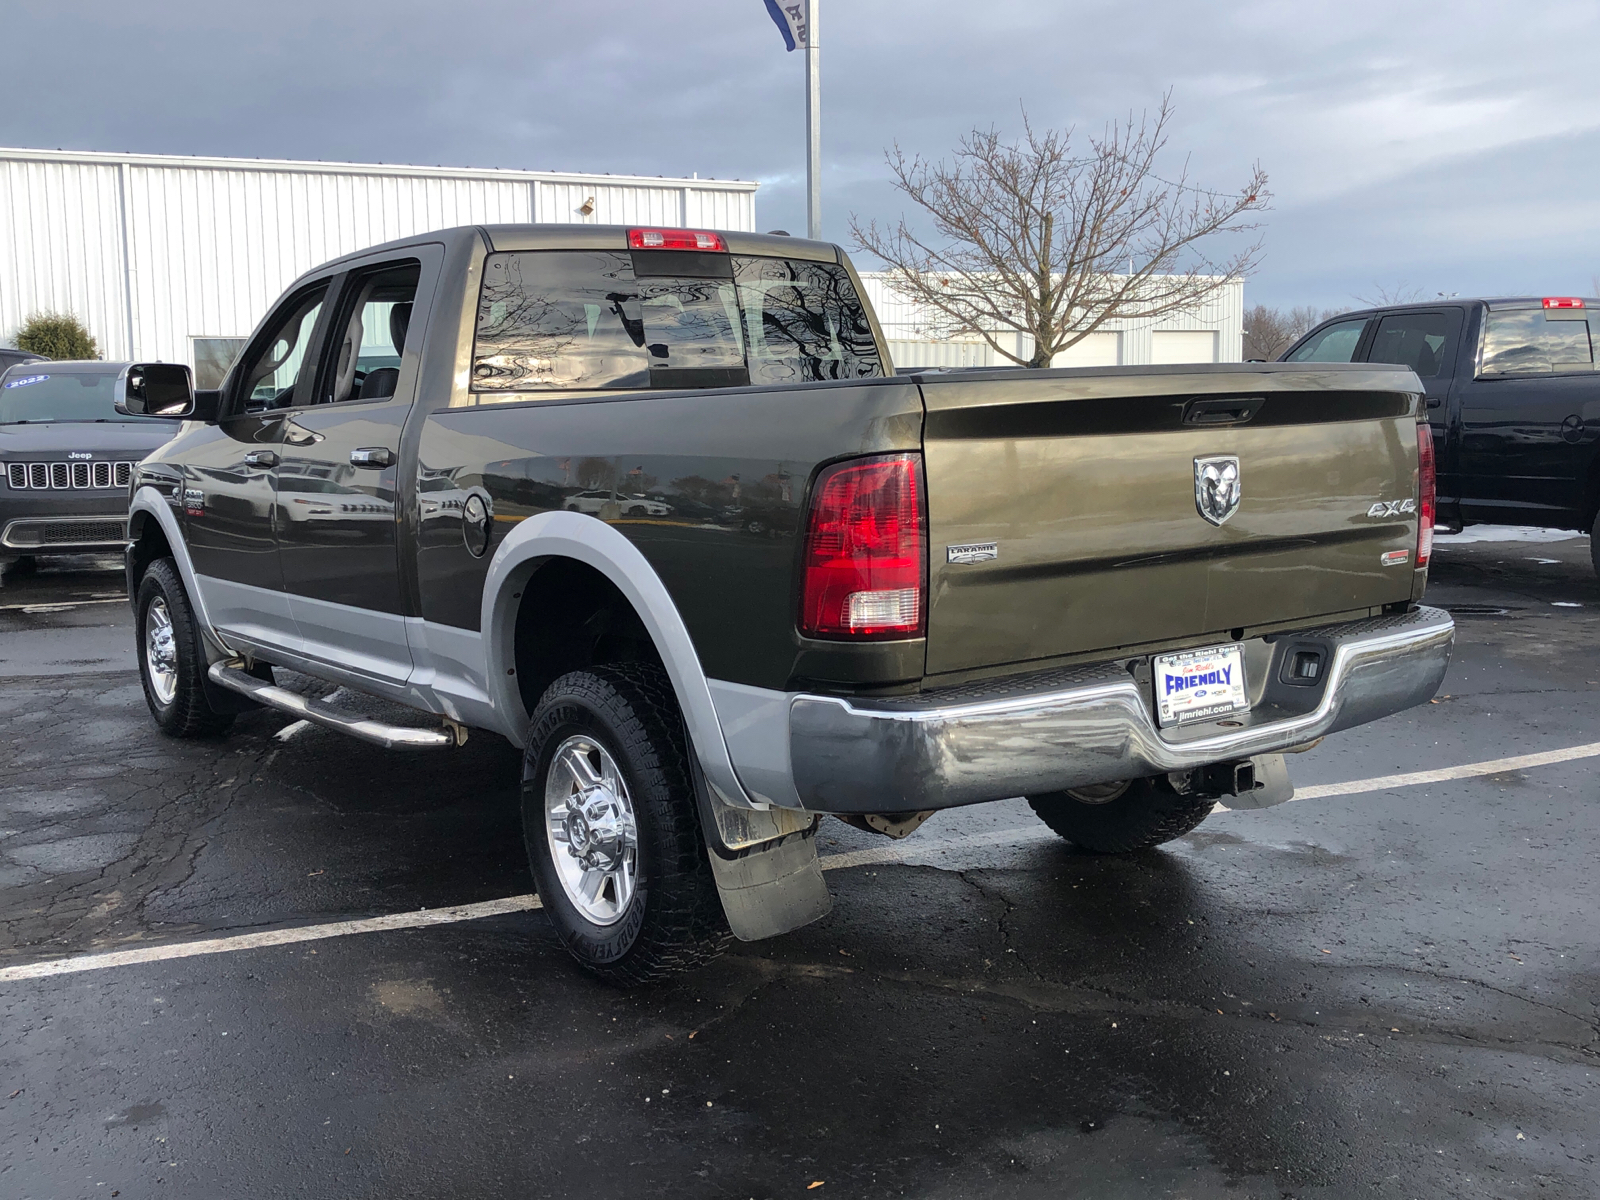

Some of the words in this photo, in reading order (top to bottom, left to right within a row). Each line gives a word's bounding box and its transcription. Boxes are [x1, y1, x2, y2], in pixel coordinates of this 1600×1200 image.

[10, 375, 45, 388] 2022
[68, 452, 92, 460] Jeep
[951, 545, 995, 554] LARAMIE
[1165, 663, 1232, 696] FRIENDLY
[1179, 703, 1232, 721] jimriehl.com
